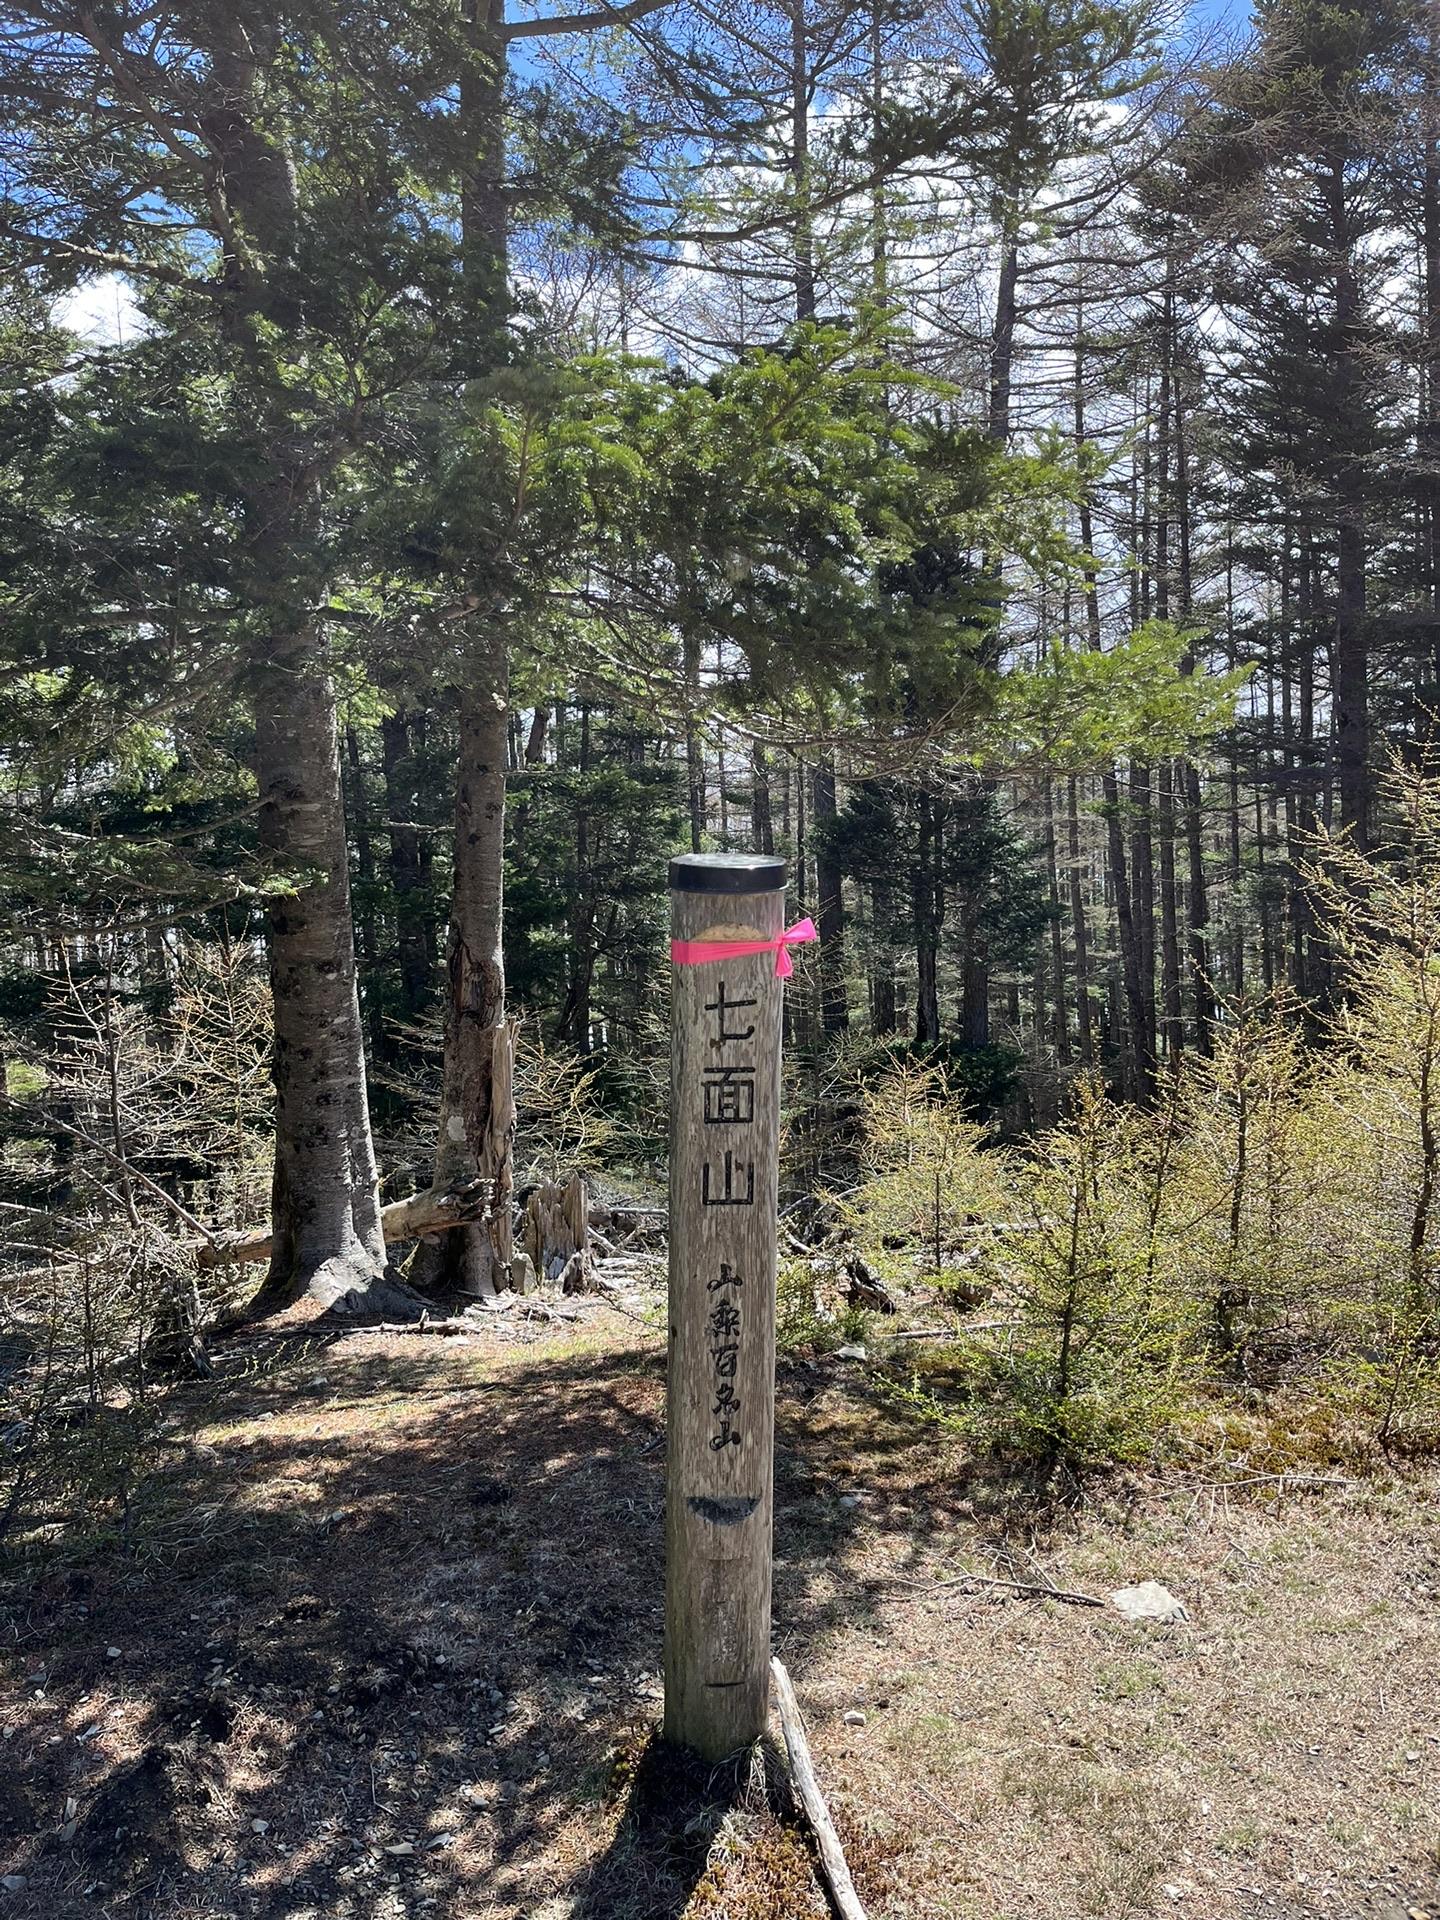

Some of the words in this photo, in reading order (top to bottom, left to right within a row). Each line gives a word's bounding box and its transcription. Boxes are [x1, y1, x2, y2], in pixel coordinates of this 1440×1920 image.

[702, 980, 757, 1205] 七面山
[706, 1263, 743, 1451] 山梨百名山
